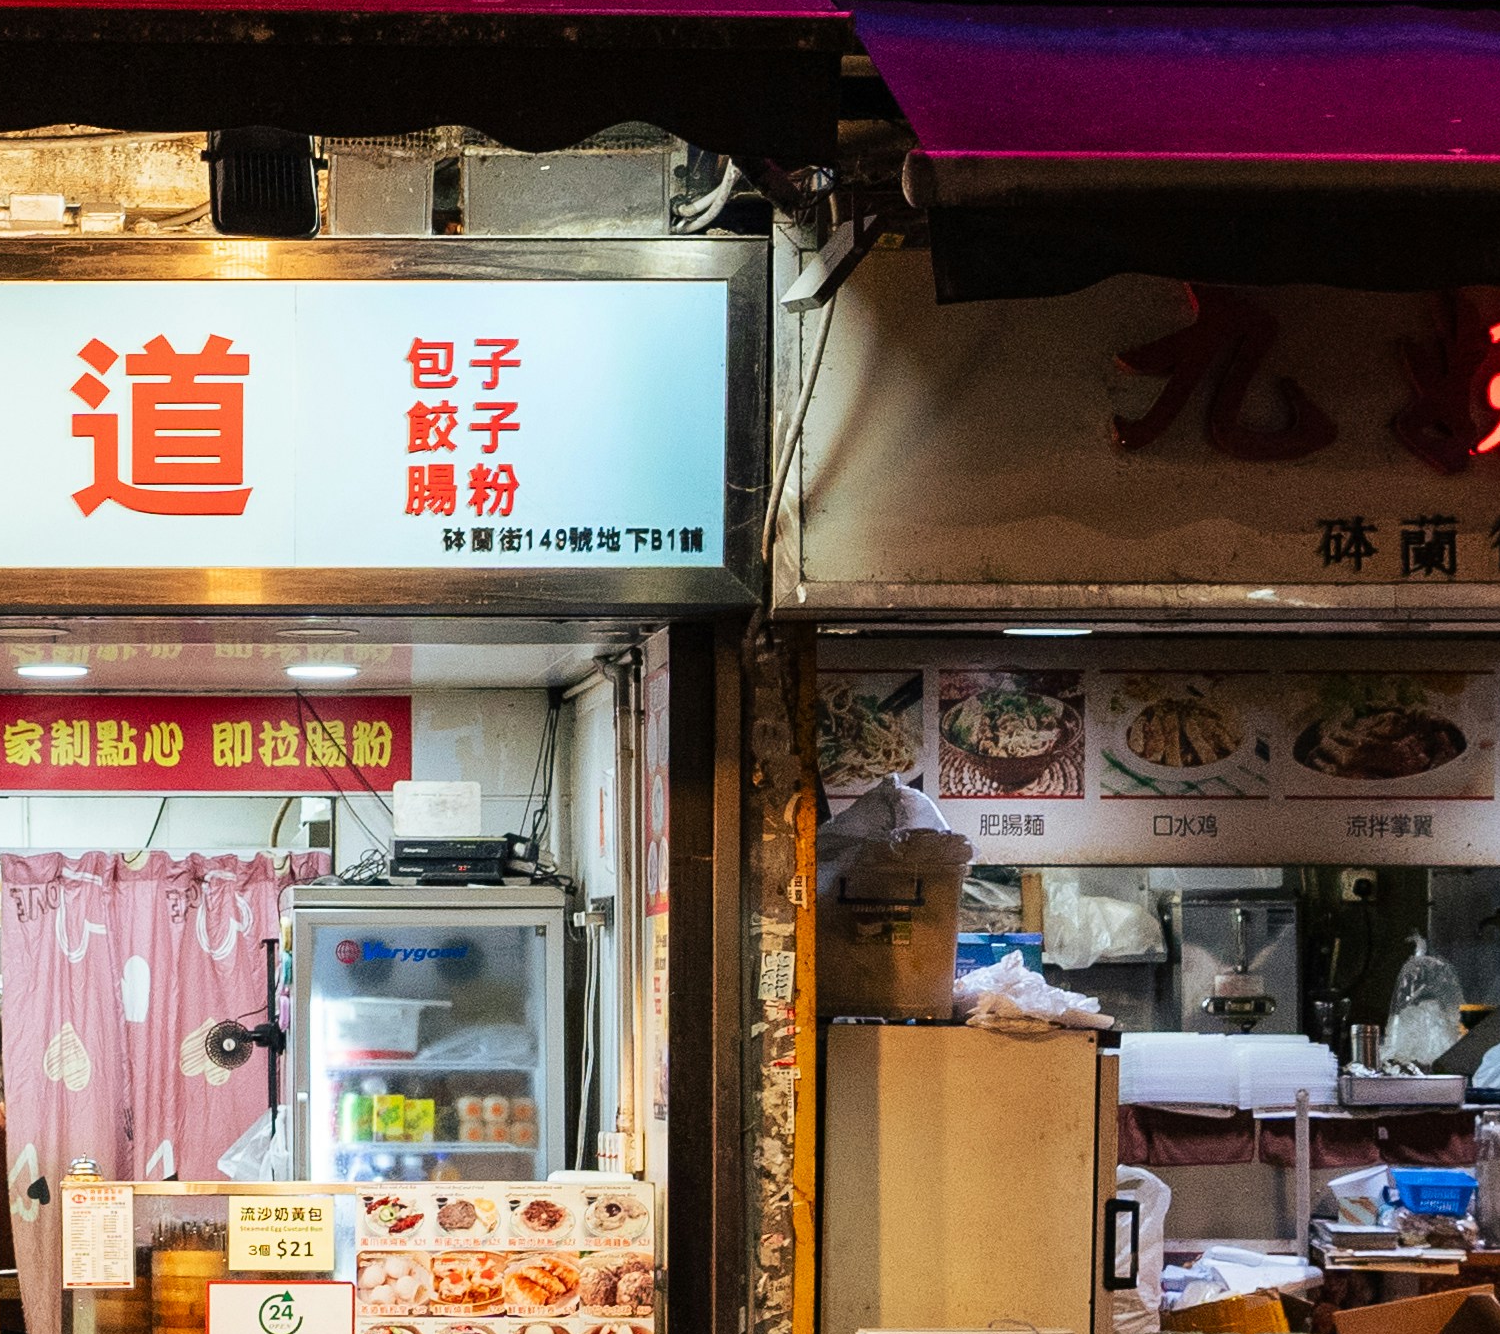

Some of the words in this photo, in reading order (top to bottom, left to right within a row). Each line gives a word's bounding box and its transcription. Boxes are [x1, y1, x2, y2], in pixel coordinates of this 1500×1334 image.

[406, 337, 522, 389] 包子
[406, 400, 522, 454] 餃子
[406, 464, 520, 517] 腸粉
[212, 718, 393, 768] 即拉腸粉
[979, 813, 1045, 838] 肥腸麵
[1153, 814, 1218, 838] 口水鸡
[248, 1244, 271, 1256] 3個
[277, 1238, 314, 1260] $21
[269, 1304, 294, 1321] 24
